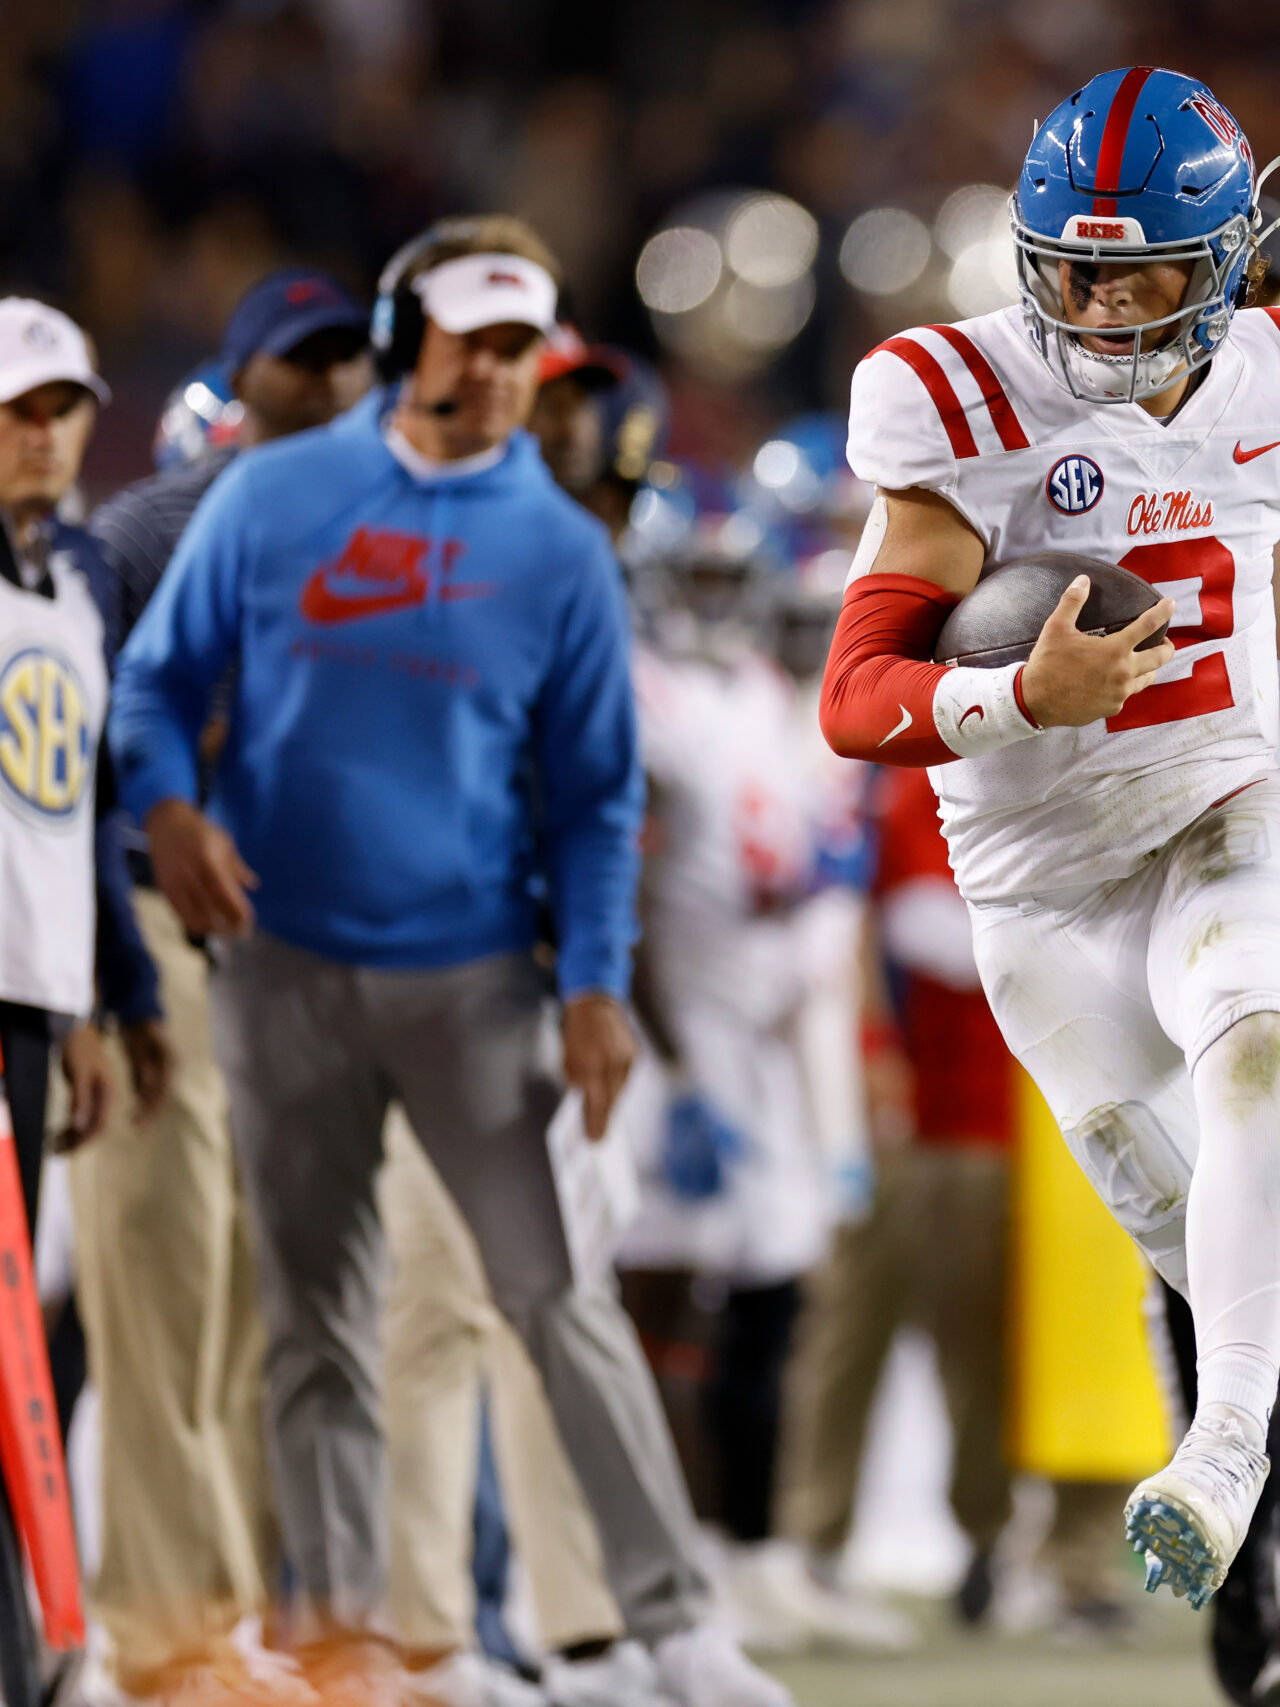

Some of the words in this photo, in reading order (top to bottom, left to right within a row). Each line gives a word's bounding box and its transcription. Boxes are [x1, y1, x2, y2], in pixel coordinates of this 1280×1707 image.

[1076, 221, 1125, 240] REBS
[1051, 458, 1100, 511] SEC
[1127, 493, 1162, 536] Ole
[1163, 489, 1215, 531] Miss
[1105, 535, 1236, 734] 2
